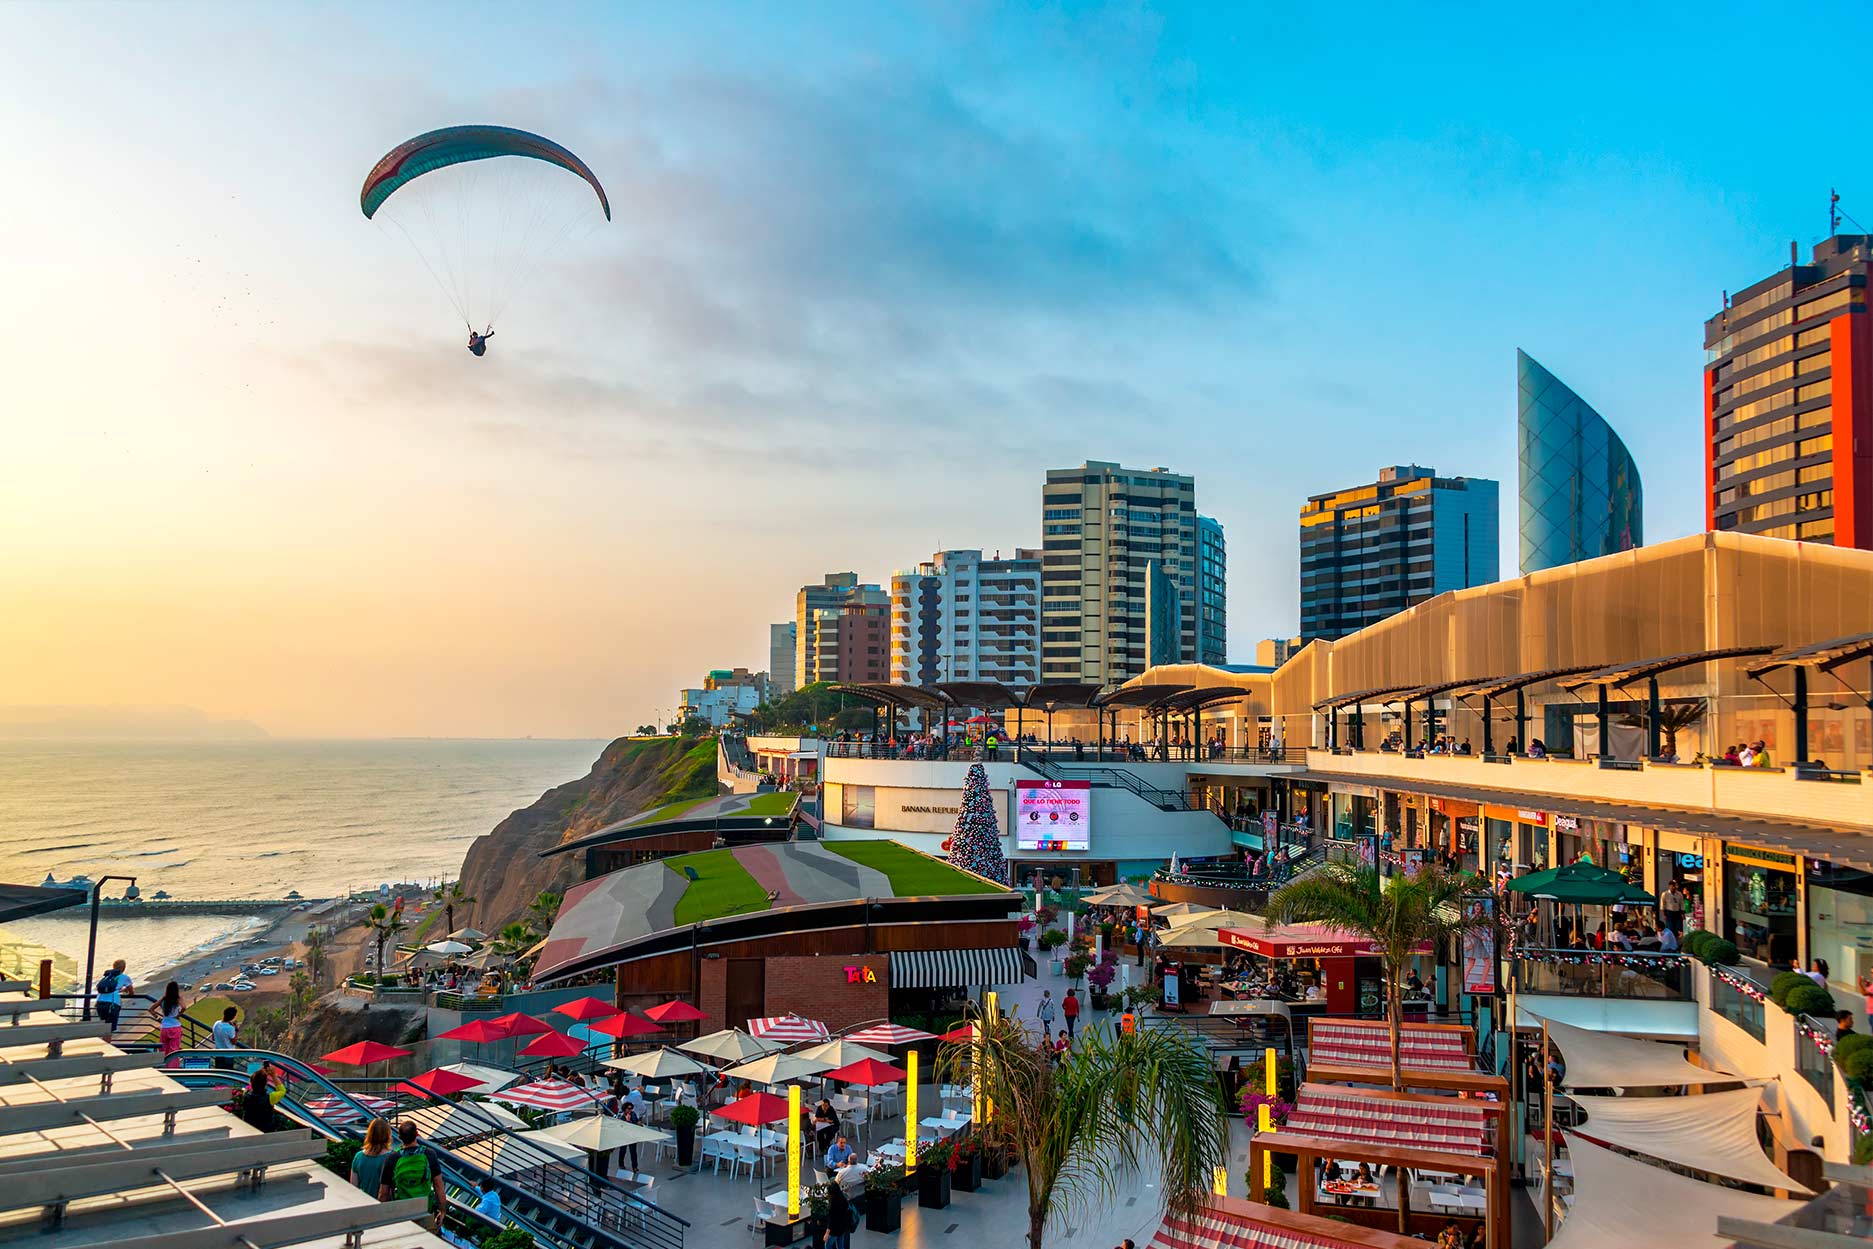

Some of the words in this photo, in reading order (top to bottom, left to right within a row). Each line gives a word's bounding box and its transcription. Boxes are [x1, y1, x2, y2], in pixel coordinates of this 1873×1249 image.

[901, 805, 931, 813] BANANA
[1296, 946, 1311, 955] Juan
[1311, 945, 1331, 954] Valdez
